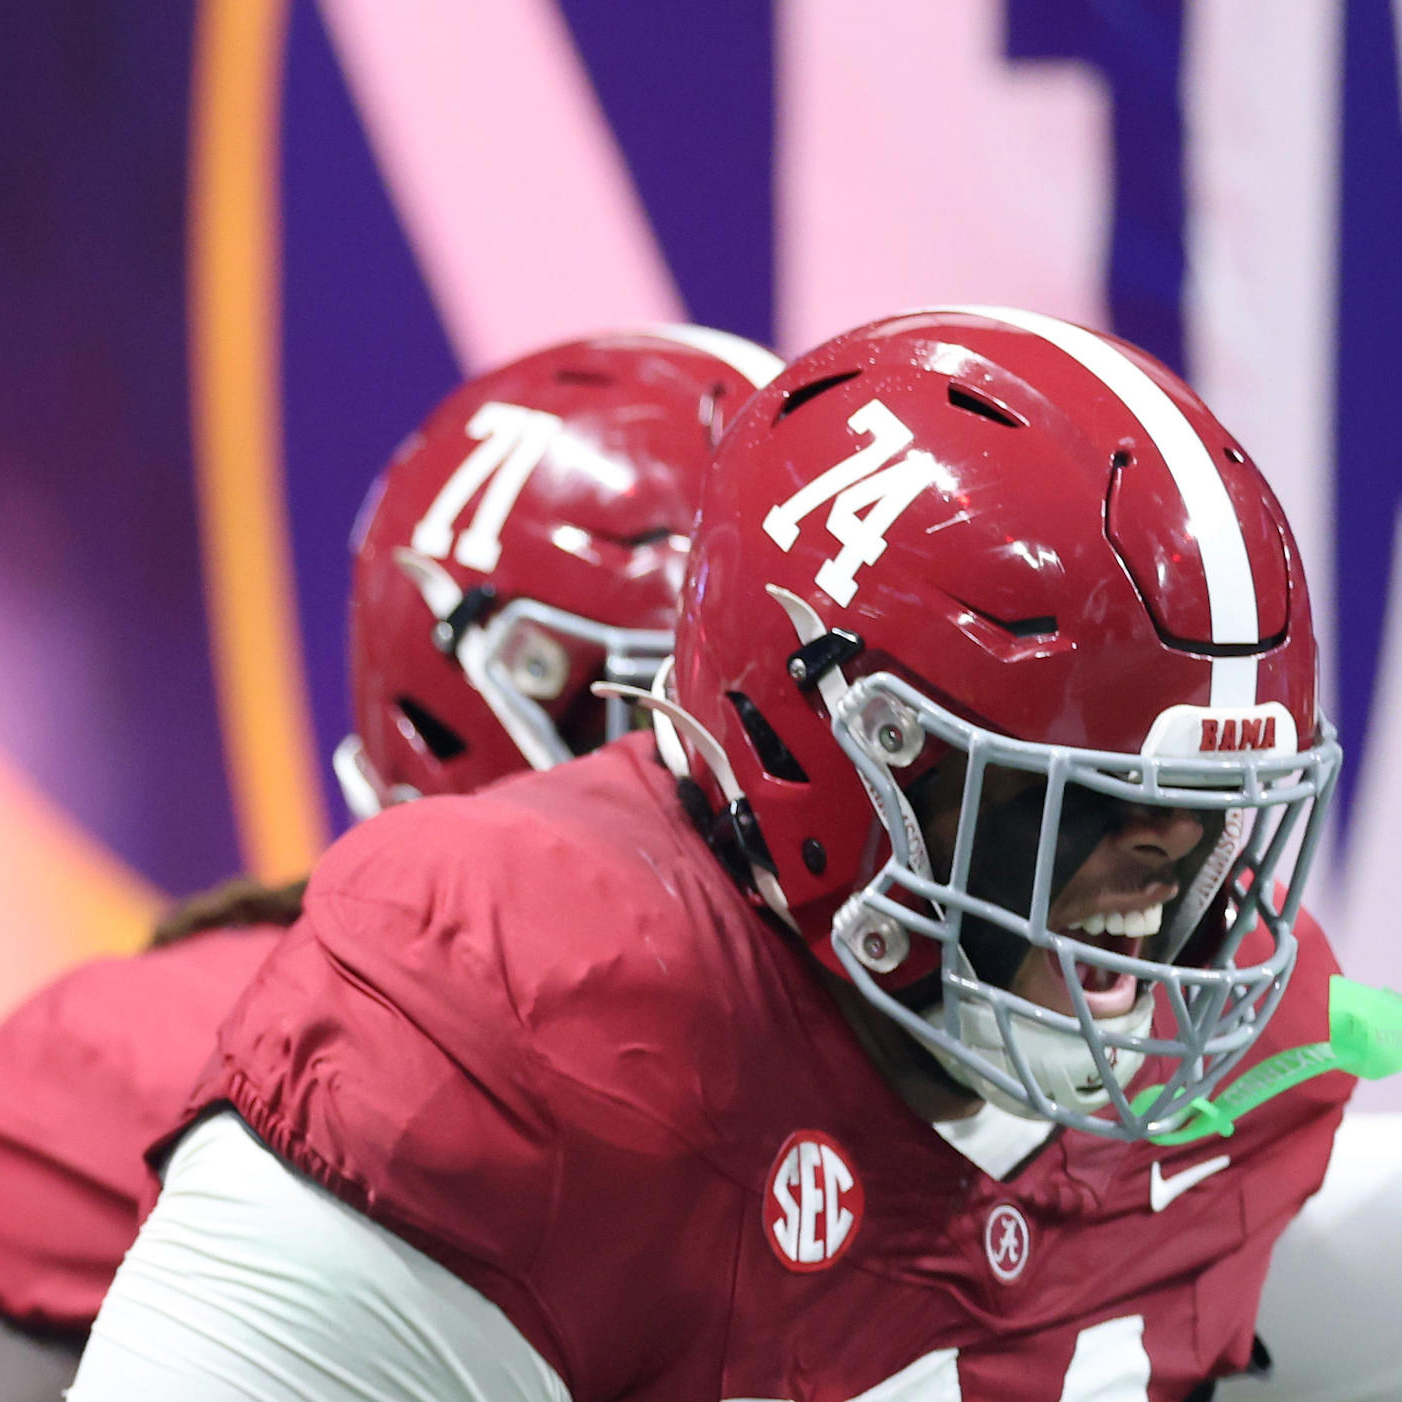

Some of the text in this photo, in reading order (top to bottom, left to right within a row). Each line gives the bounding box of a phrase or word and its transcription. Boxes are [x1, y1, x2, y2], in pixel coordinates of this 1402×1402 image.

[761, 398, 938, 608] 74
[1199, 716, 1276, 752] BAMA
[772, 1141, 854, 1262] SEC
